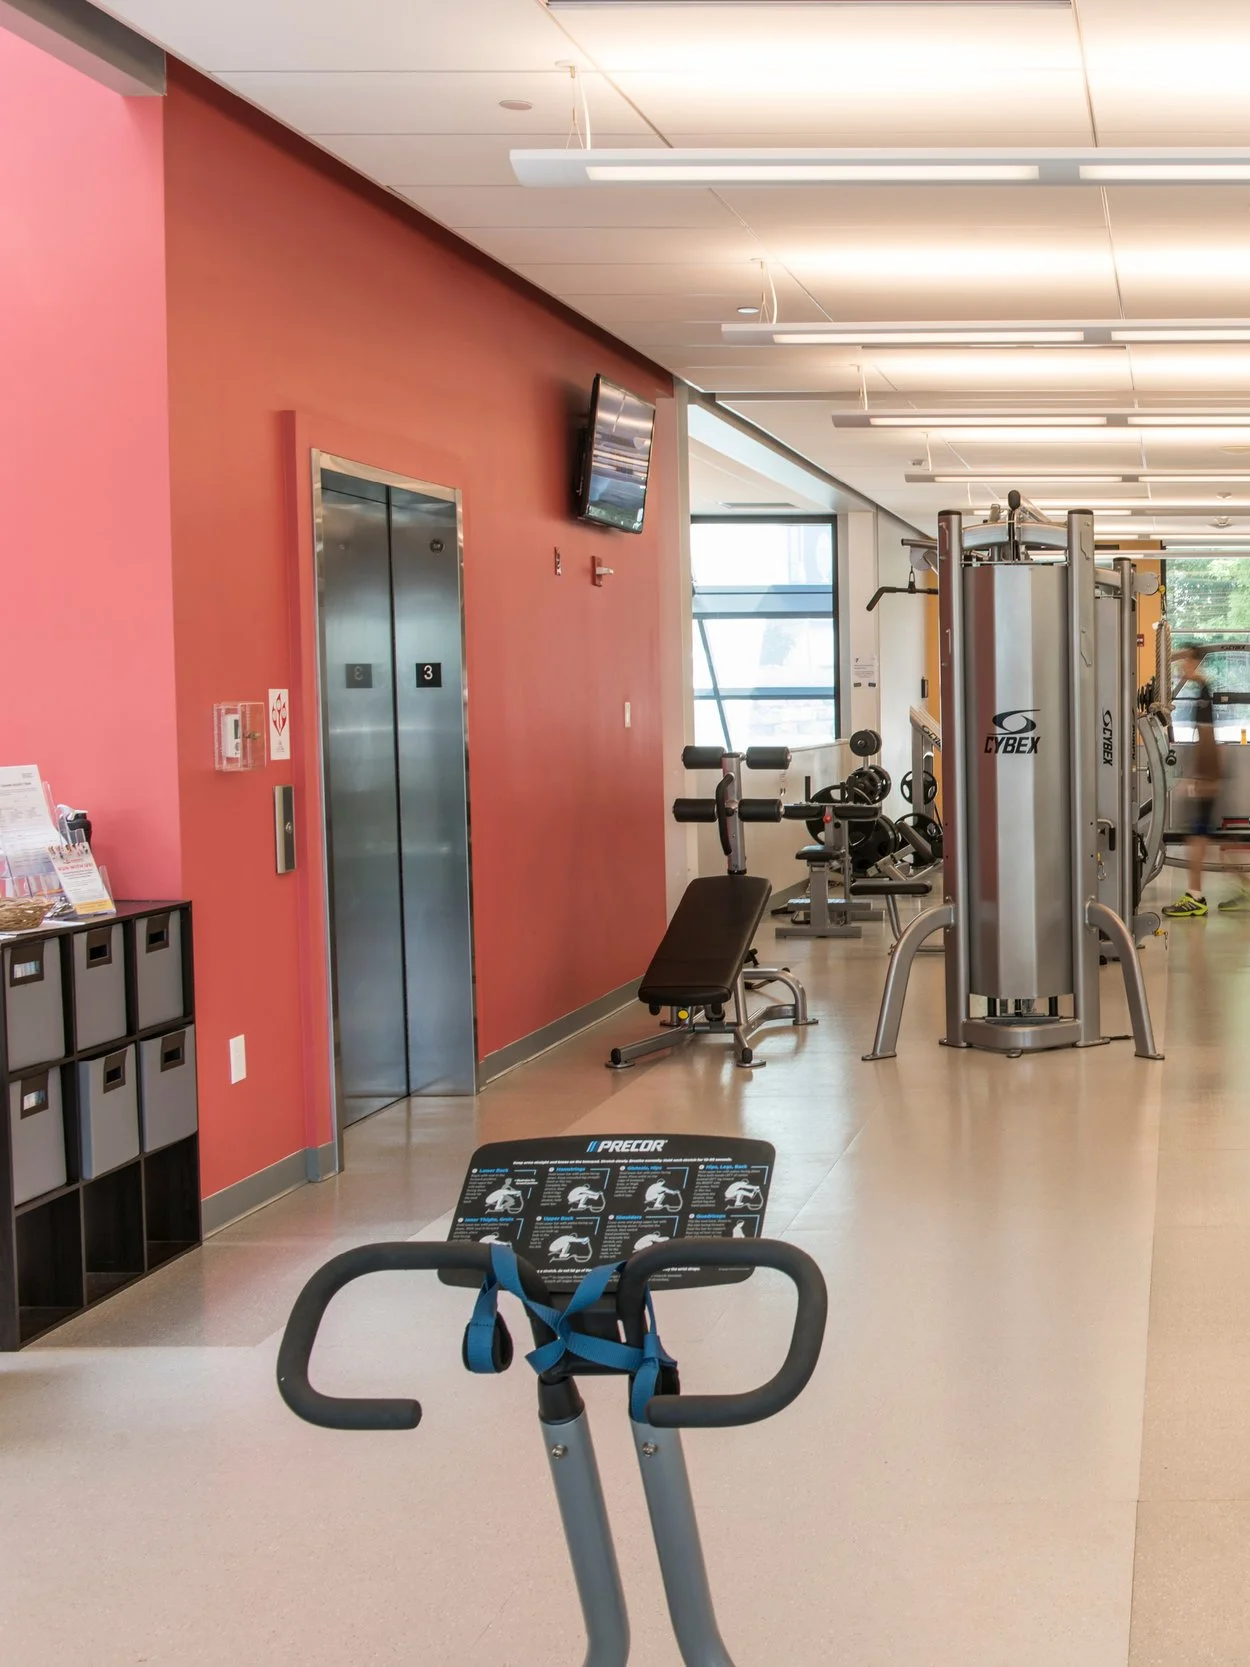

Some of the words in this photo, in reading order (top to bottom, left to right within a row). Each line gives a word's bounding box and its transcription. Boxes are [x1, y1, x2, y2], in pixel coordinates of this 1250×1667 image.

[423, 665, 433, 680] 3
[984, 736, 1041, 754] CYBEX
[1103, 728, 1113, 766] CYBEX
[598, 1140, 664, 1153] PRECOR
